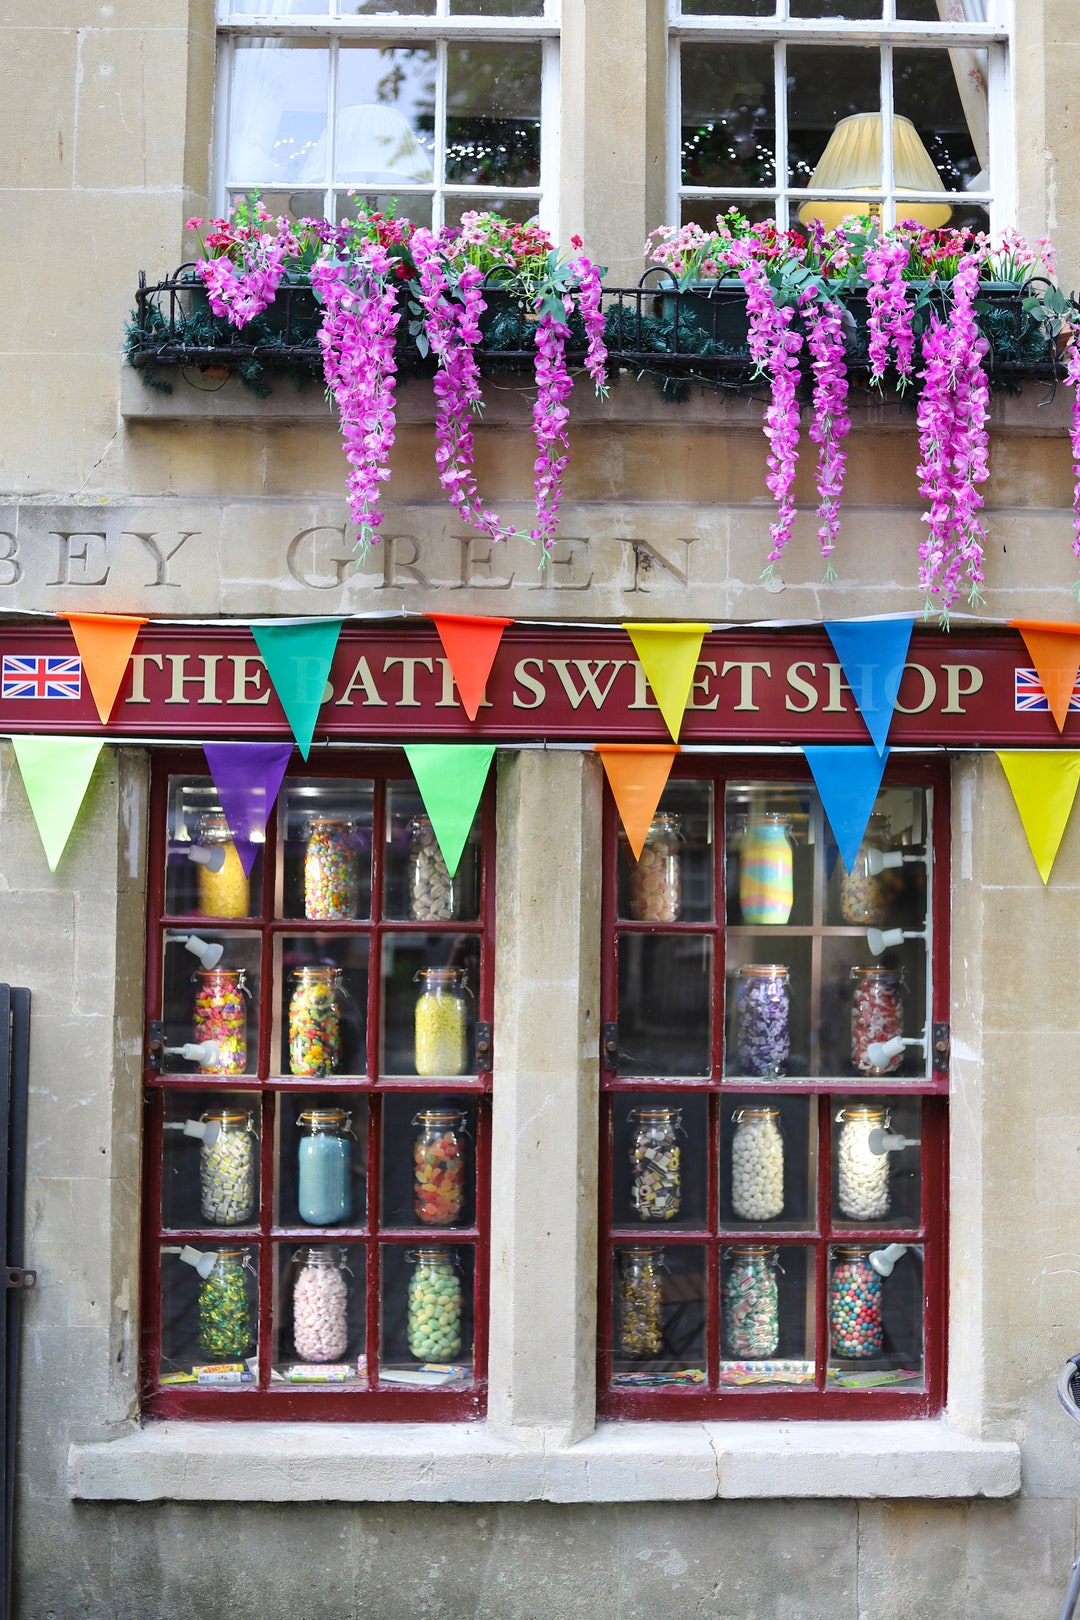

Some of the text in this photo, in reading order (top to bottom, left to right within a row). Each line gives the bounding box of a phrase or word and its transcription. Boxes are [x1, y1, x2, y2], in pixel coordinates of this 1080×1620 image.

[286, 524, 700, 593] GREEN
[125, 653, 272, 706] THE
[512, 657, 772, 712] SWEET
[784, 662, 985, 716] SHOP
